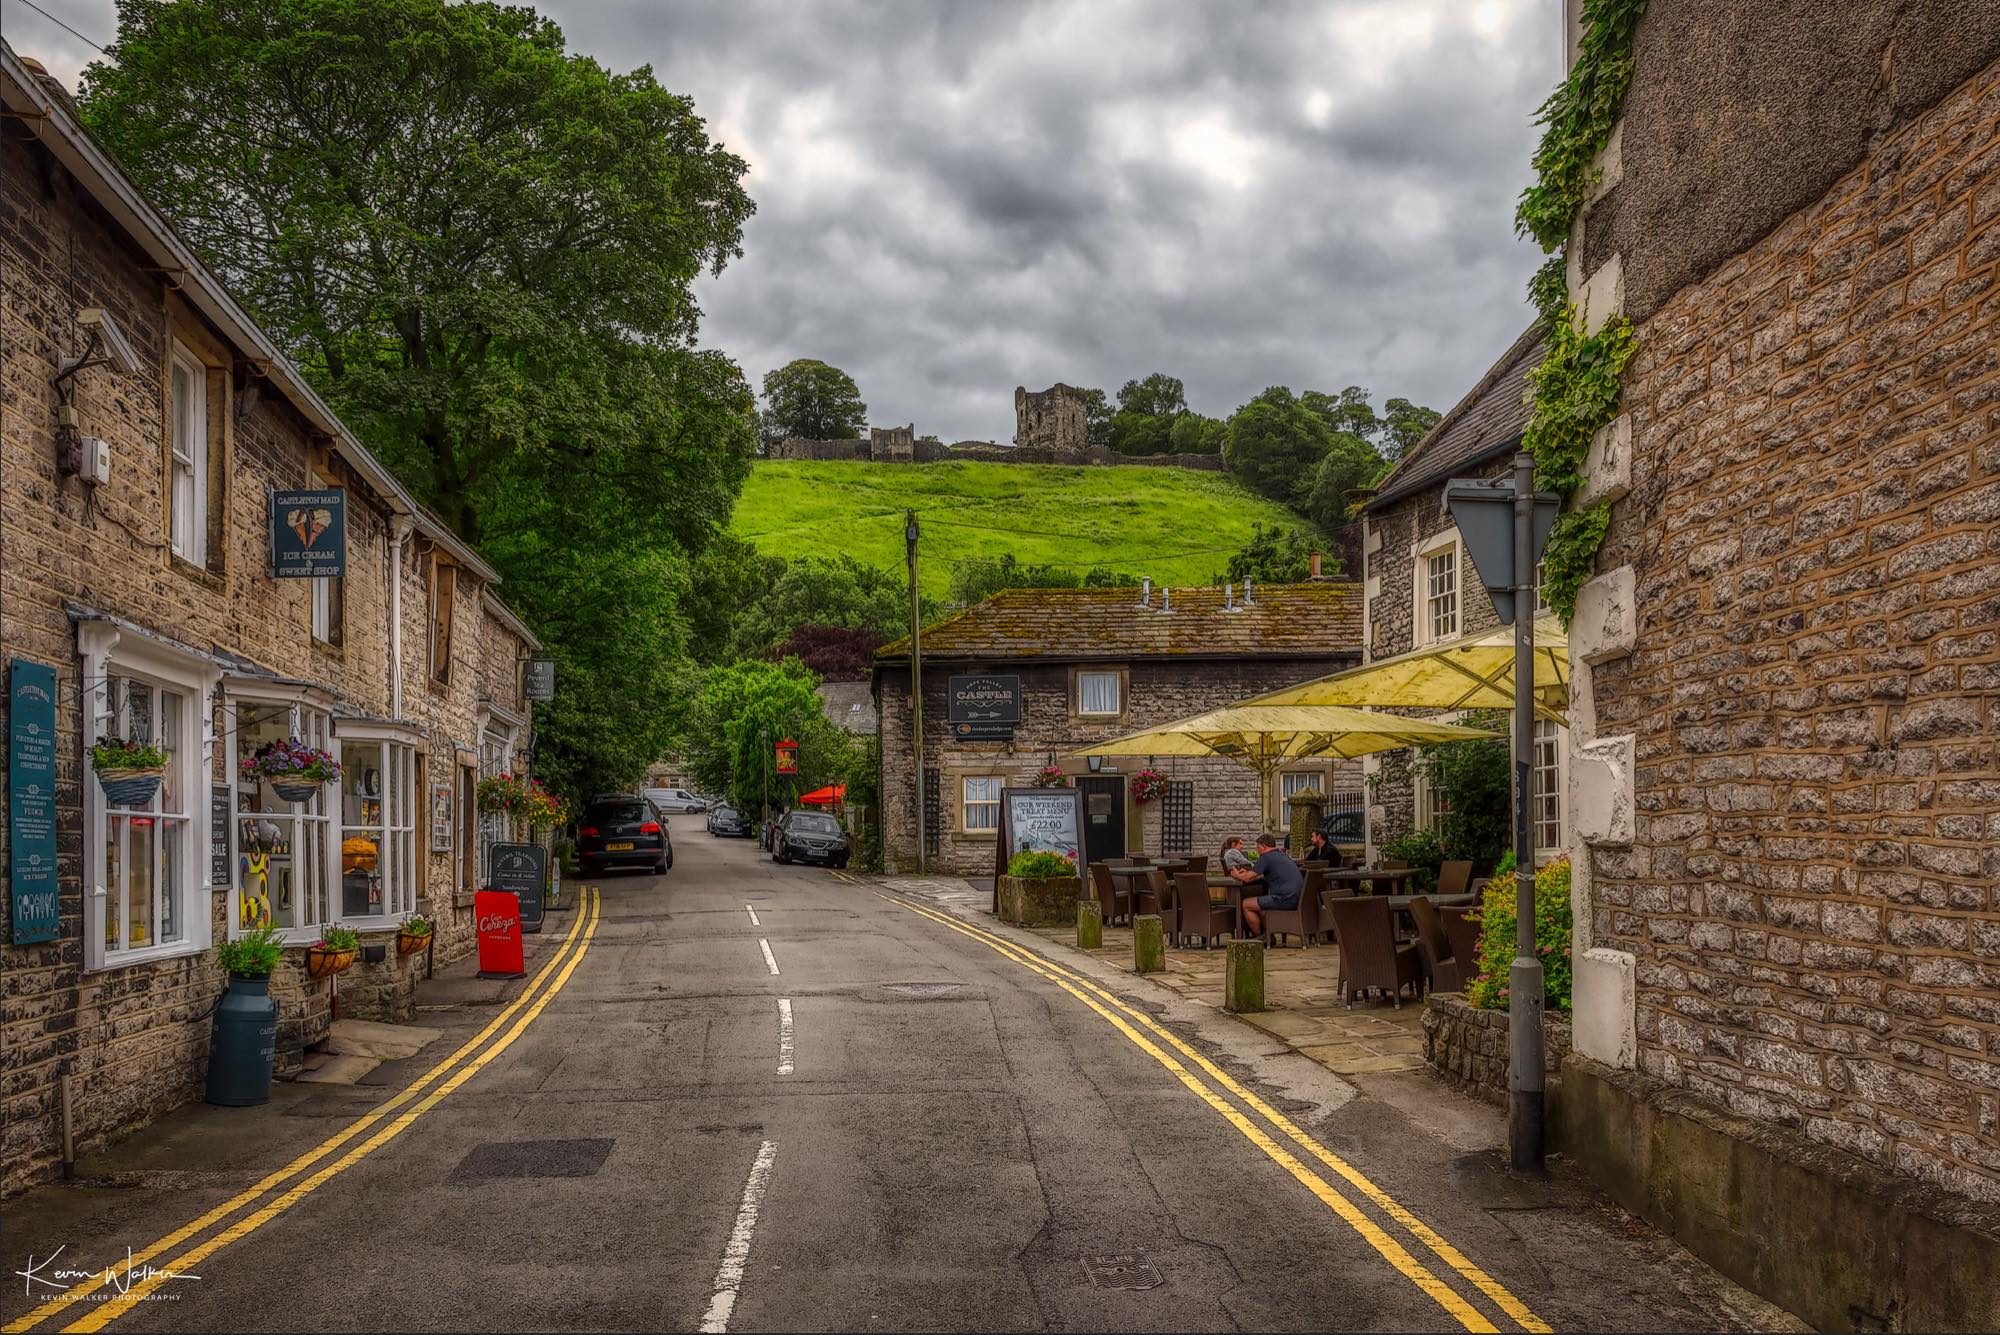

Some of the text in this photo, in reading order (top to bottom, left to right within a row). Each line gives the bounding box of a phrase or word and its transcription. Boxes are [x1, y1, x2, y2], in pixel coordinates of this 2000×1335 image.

[320, 496, 340, 505] MAID
[283, 550, 336, 560] ICE CREAM
[279, 566, 340, 576] SWEET SHOP
[956, 690, 1013, 700] CASTLE
[1017, 801, 1073, 809] OUR WEEKEND
[1020, 807, 1070, 815] TREAT MENU
[1031, 819, 1062, 830] £22.00
[211, 842, 227, 857] SALE
[479, 916, 517, 934] Cereza
